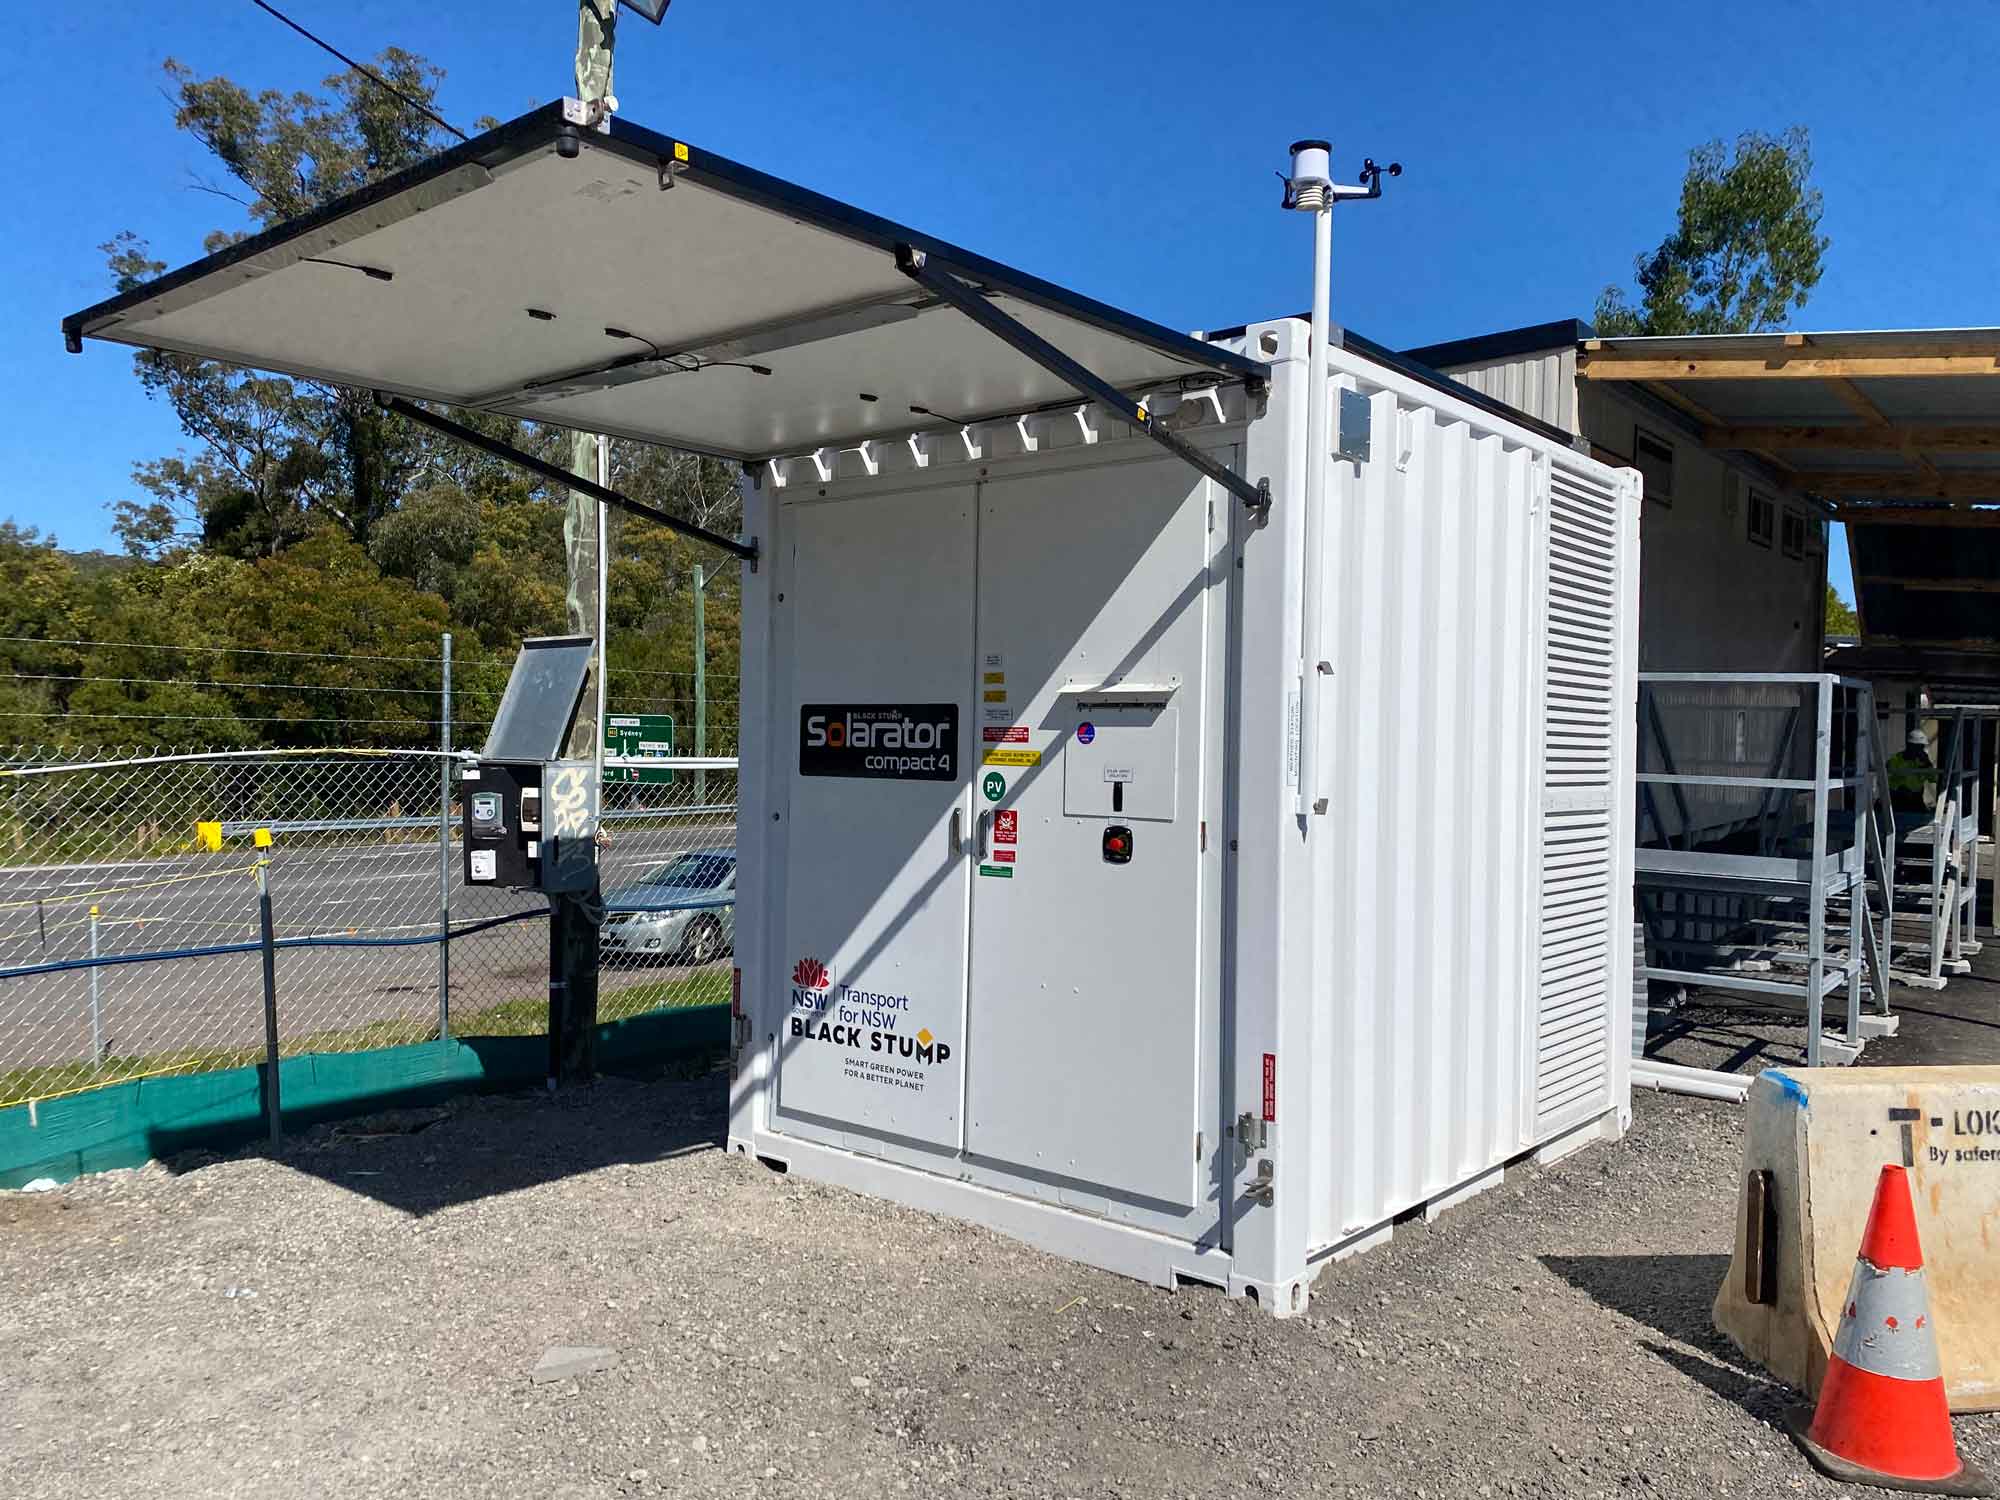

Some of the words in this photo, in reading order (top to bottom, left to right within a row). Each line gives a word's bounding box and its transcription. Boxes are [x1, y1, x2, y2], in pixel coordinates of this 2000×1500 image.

[619, 729, 642, 738] Sydney
[807, 711, 950, 748] Solarator
[865, 755, 936, 774] compact
[938, 754, 950, 771] 4
[986, 781, 1003, 793] PV
[792, 989, 828, 1010] NSW
[839, 984, 909, 1011] Transport
[839, 1005, 858, 1023] for
[861, 1009, 896, 1030] NSW
[791, 1017, 862, 1048] BLACK
[870, 1031, 951, 1066] STUMP
[844, 1057, 869, 1069] SMART
[870, 1063, 895, 1074] GREEN
[896, 1068, 924, 1080] POWER
[844, 1068, 859, 1077] FOR
[866, 1074, 894, 1085] BETTER
[895, 1079, 924, 1092] PLANET
[1930, 1146, 1949, 1165] By
